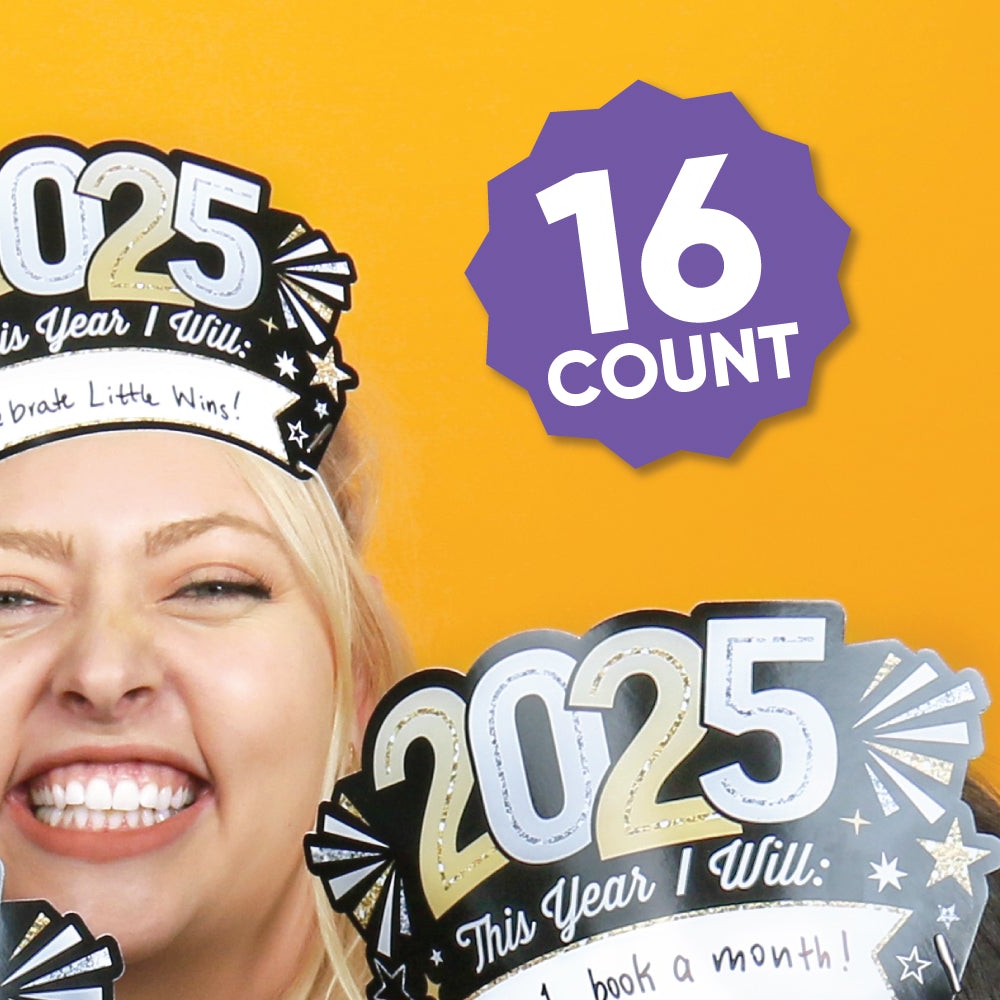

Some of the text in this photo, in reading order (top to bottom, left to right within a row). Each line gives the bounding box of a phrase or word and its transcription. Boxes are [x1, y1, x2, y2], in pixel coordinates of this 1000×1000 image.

[35, 305, 130, 353] Year
[144, 305, 159, 336] I
[169, 309, 252, 357] Will:
[89, 380, 160, 409] Little
[171, 390, 240, 422] Wins!
[373, 616, 838, 920] 2025
[455, 837, 831, 973] This Year I Will:
[673, 955, 695, 983] a
[711, 930, 851, 974] month!
